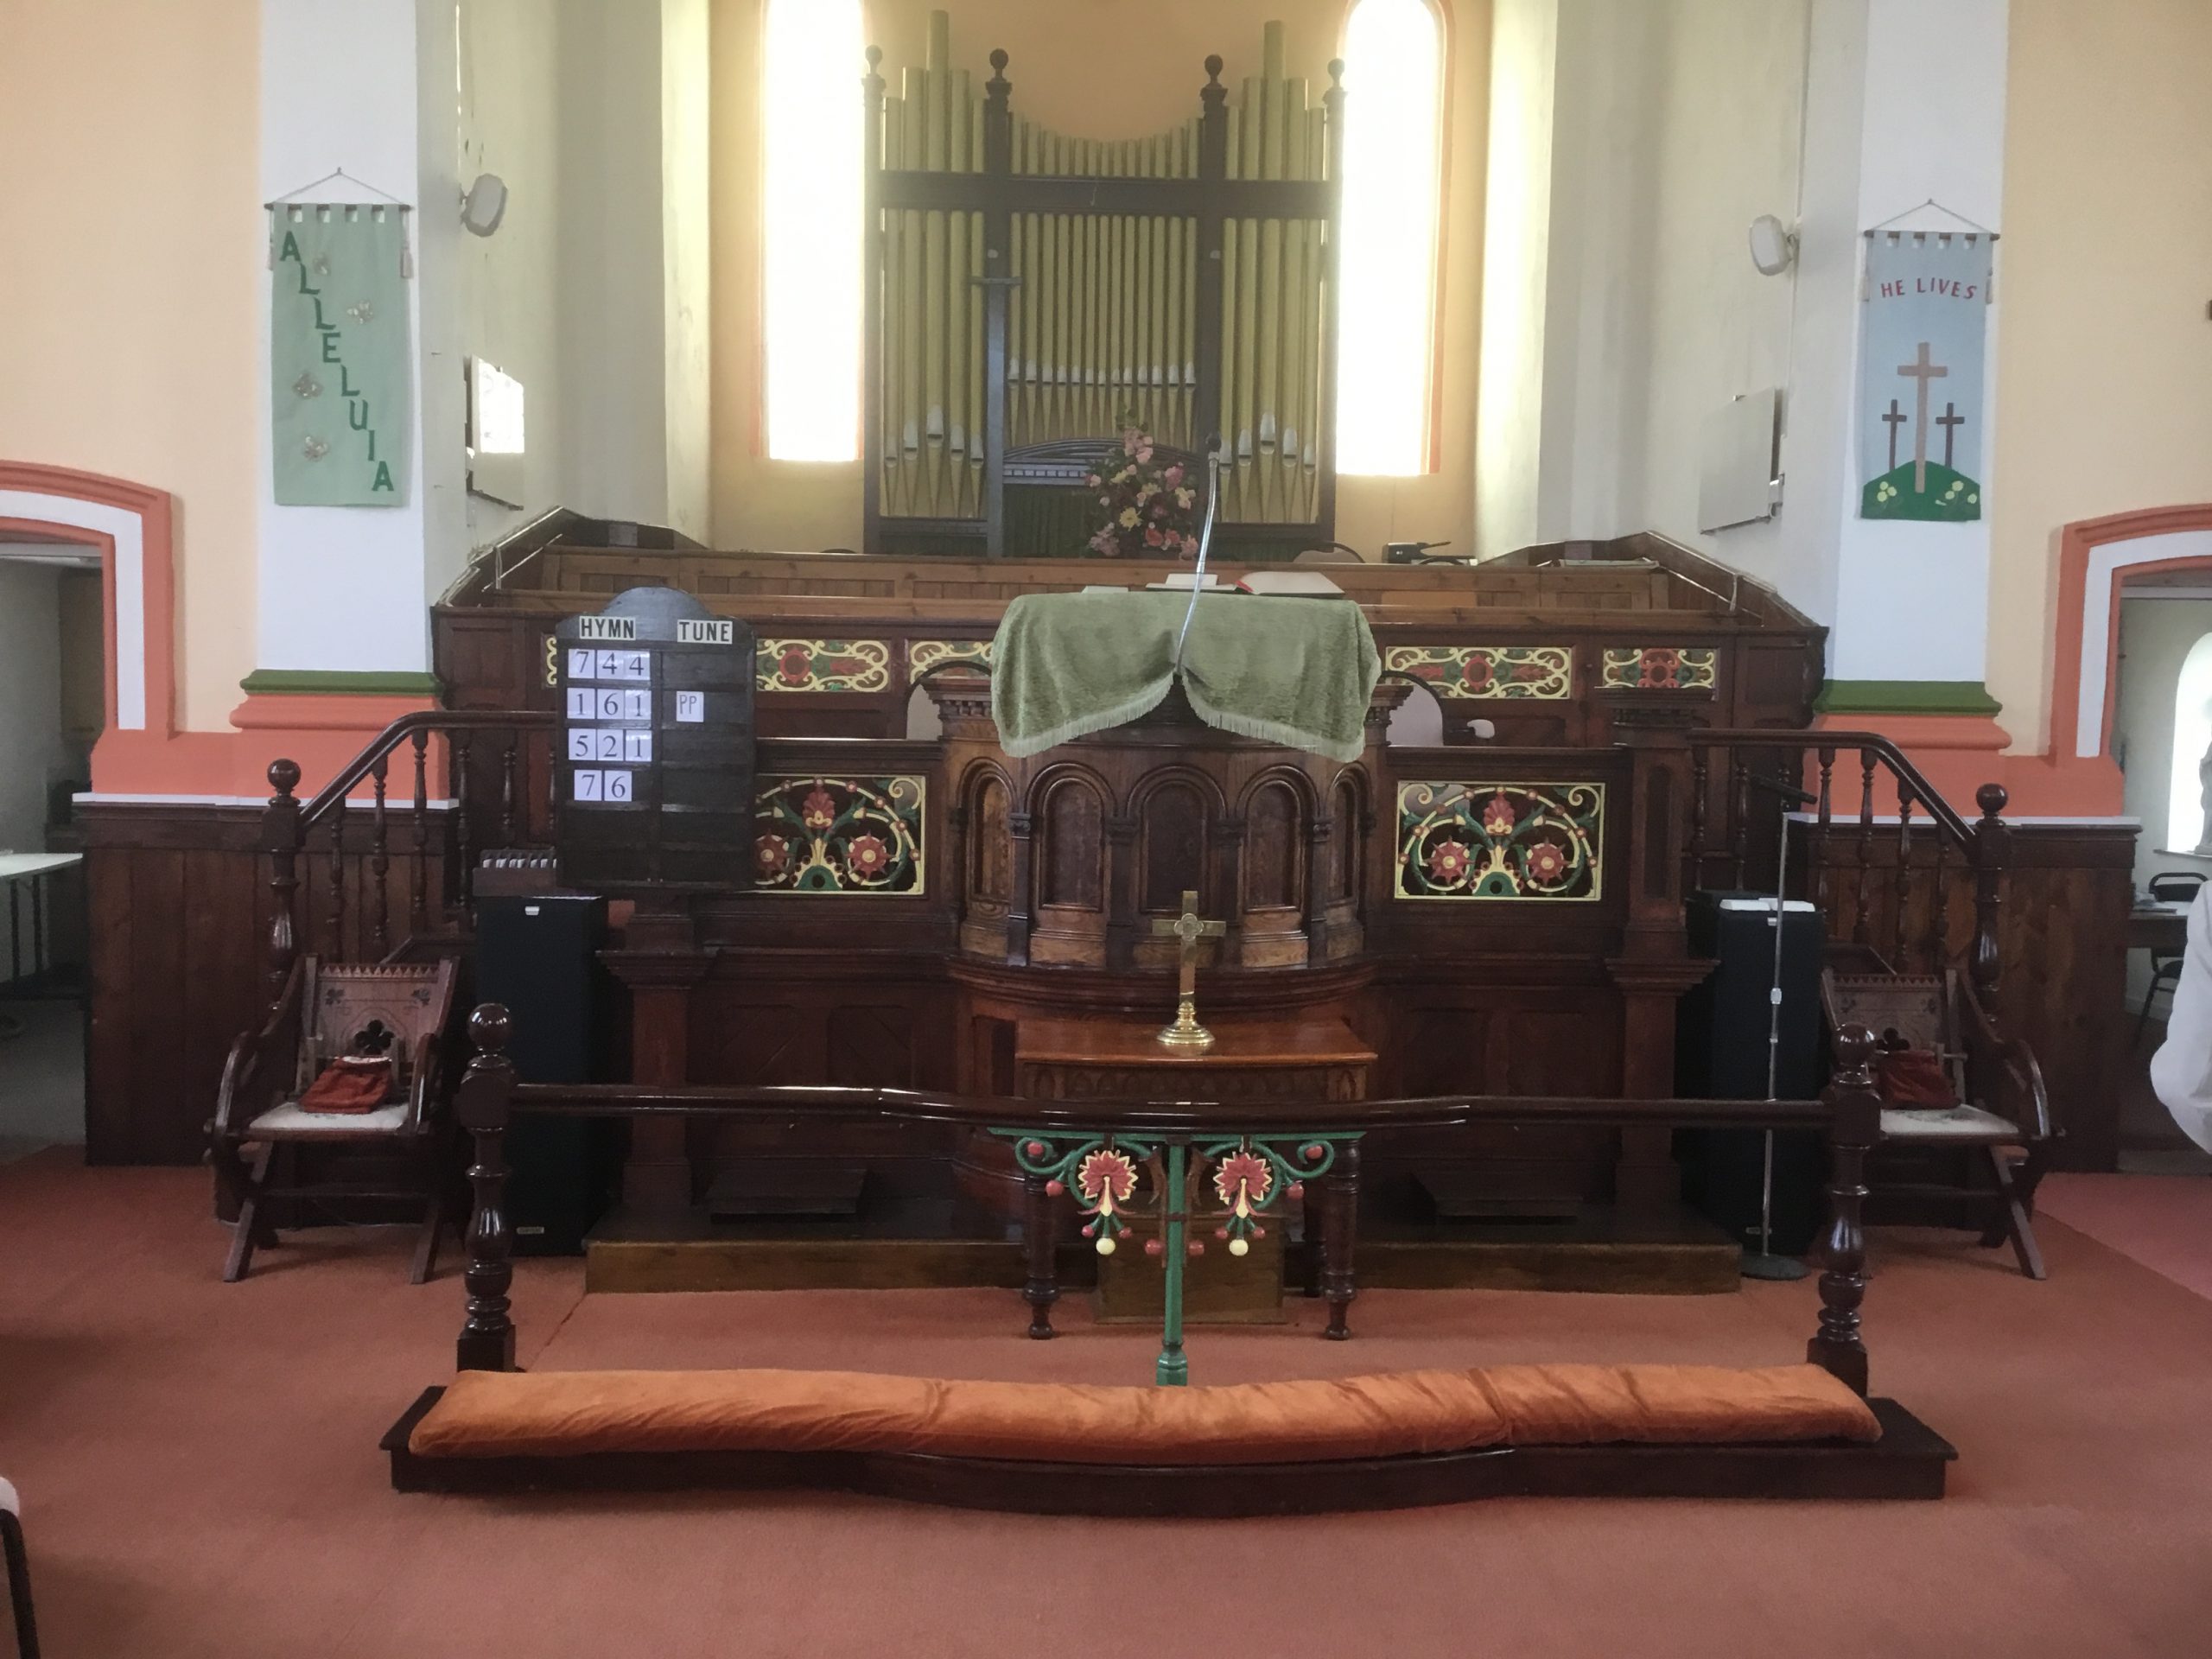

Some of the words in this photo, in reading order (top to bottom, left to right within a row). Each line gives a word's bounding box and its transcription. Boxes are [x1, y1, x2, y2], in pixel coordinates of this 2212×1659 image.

[1880, 279, 1906, 298] HE
[1916, 277, 1978, 300] LIVES
[279, 230, 394, 492] ALLELUIA
[581, 618, 635, 639] HYMN
[679, 621, 731, 642] TUNE
[575, 651, 645, 677] 744
[576, 692, 642, 717] 161
[679, 694, 697, 715] PP
[575, 735, 642, 758] 521
[581, 774, 626, 798] 76
